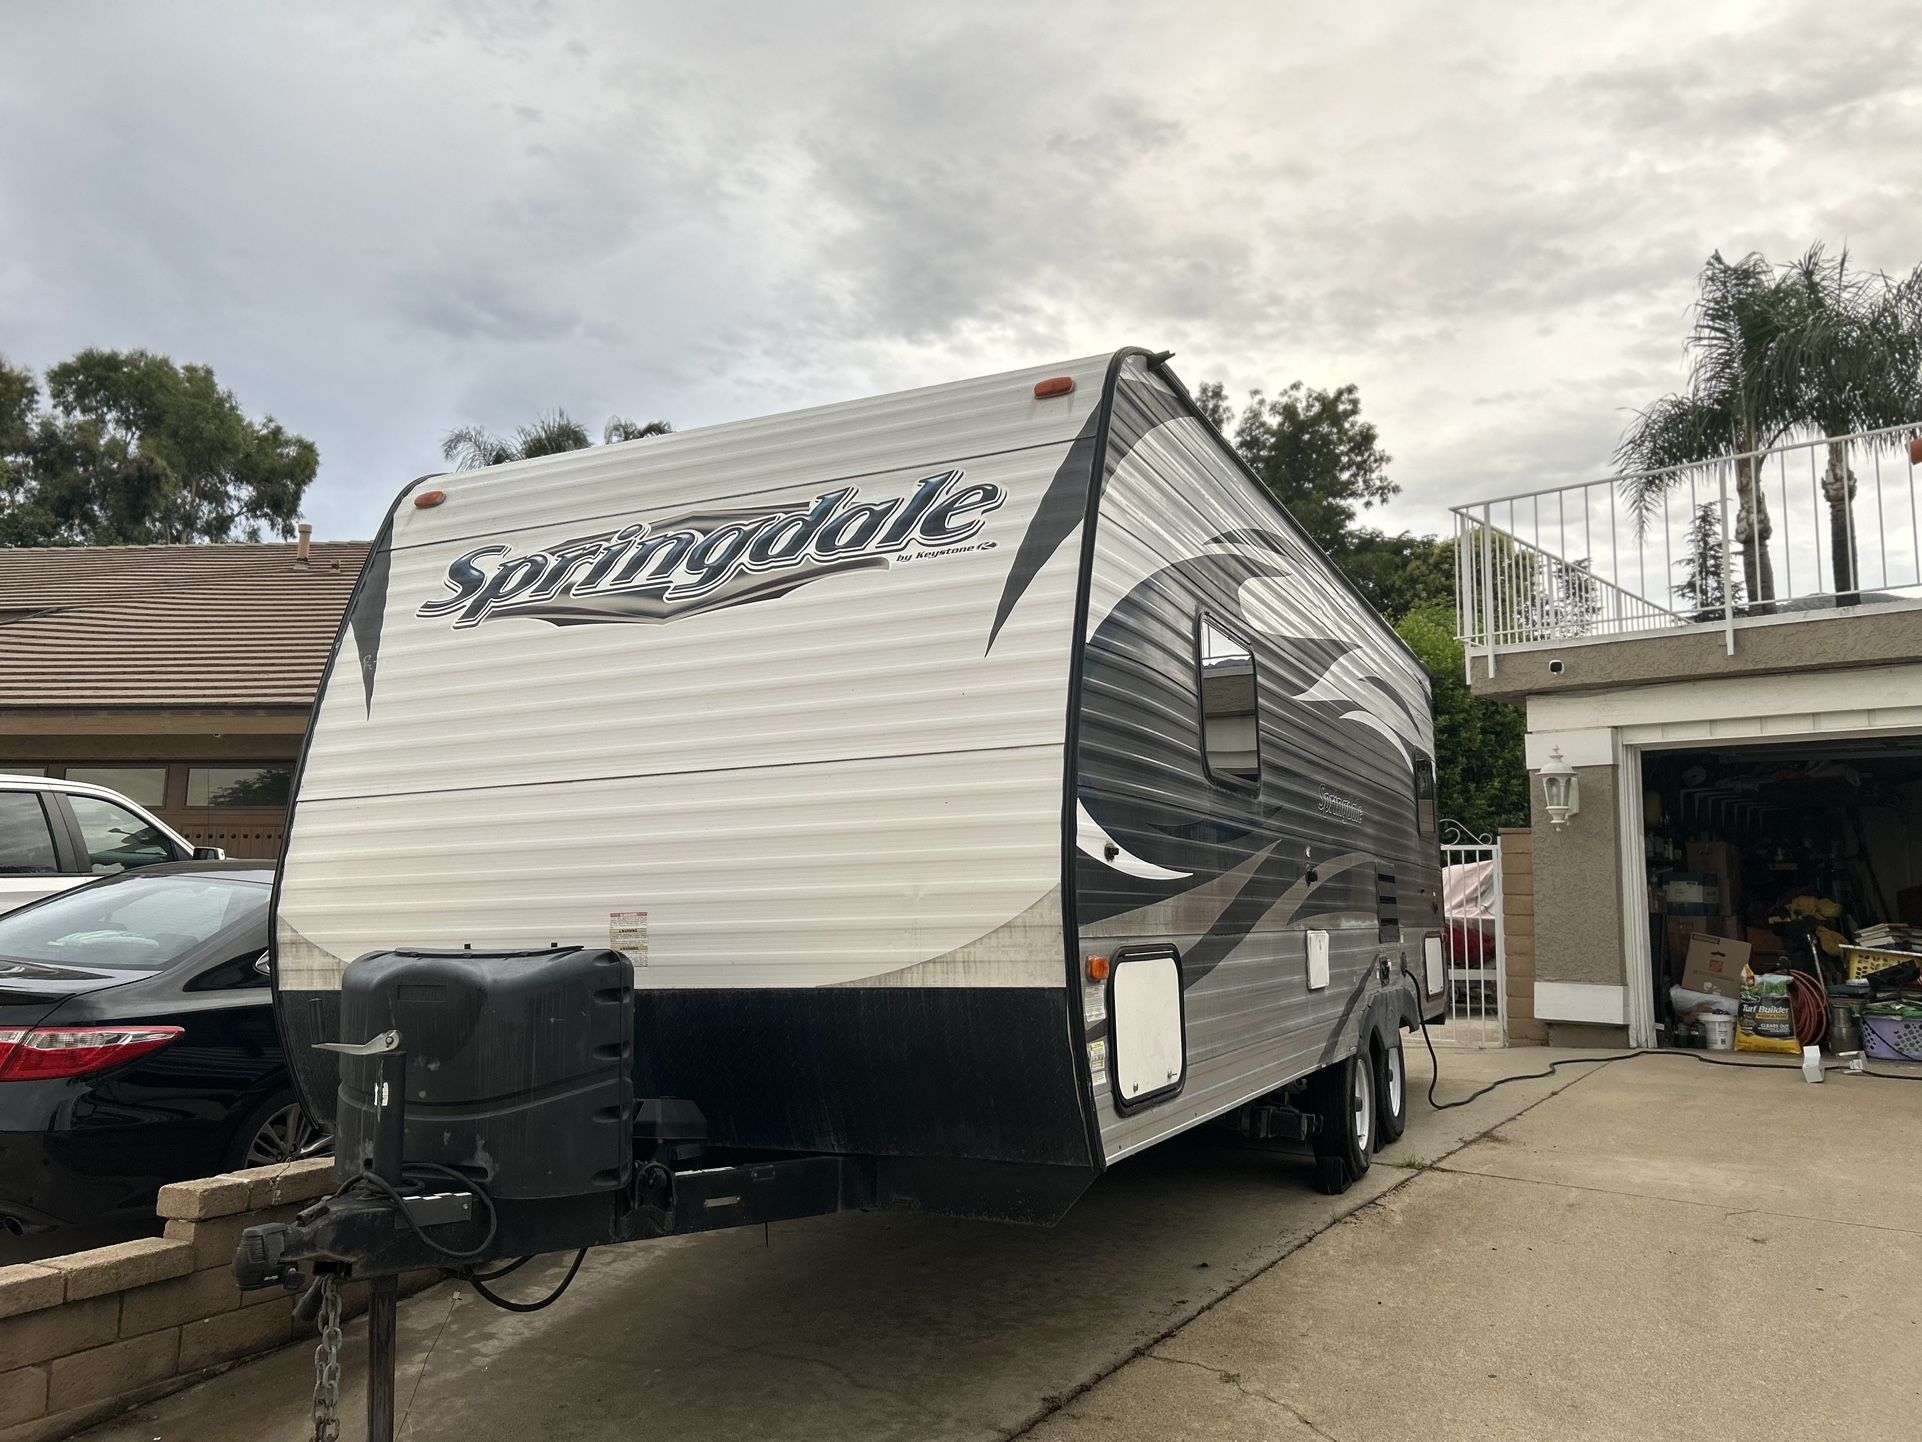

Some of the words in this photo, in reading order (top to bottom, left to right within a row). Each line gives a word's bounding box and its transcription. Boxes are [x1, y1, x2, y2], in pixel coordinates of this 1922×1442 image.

[416, 469, 1007, 630] Springdale
[896, 554, 913, 563] by
[916, 545, 974, 559] Keystone
[1317, 783, 1364, 825] Springdale
[1742, 1004, 1757, 1013] Turf
[1758, 1005, 1790, 1014] Builder
